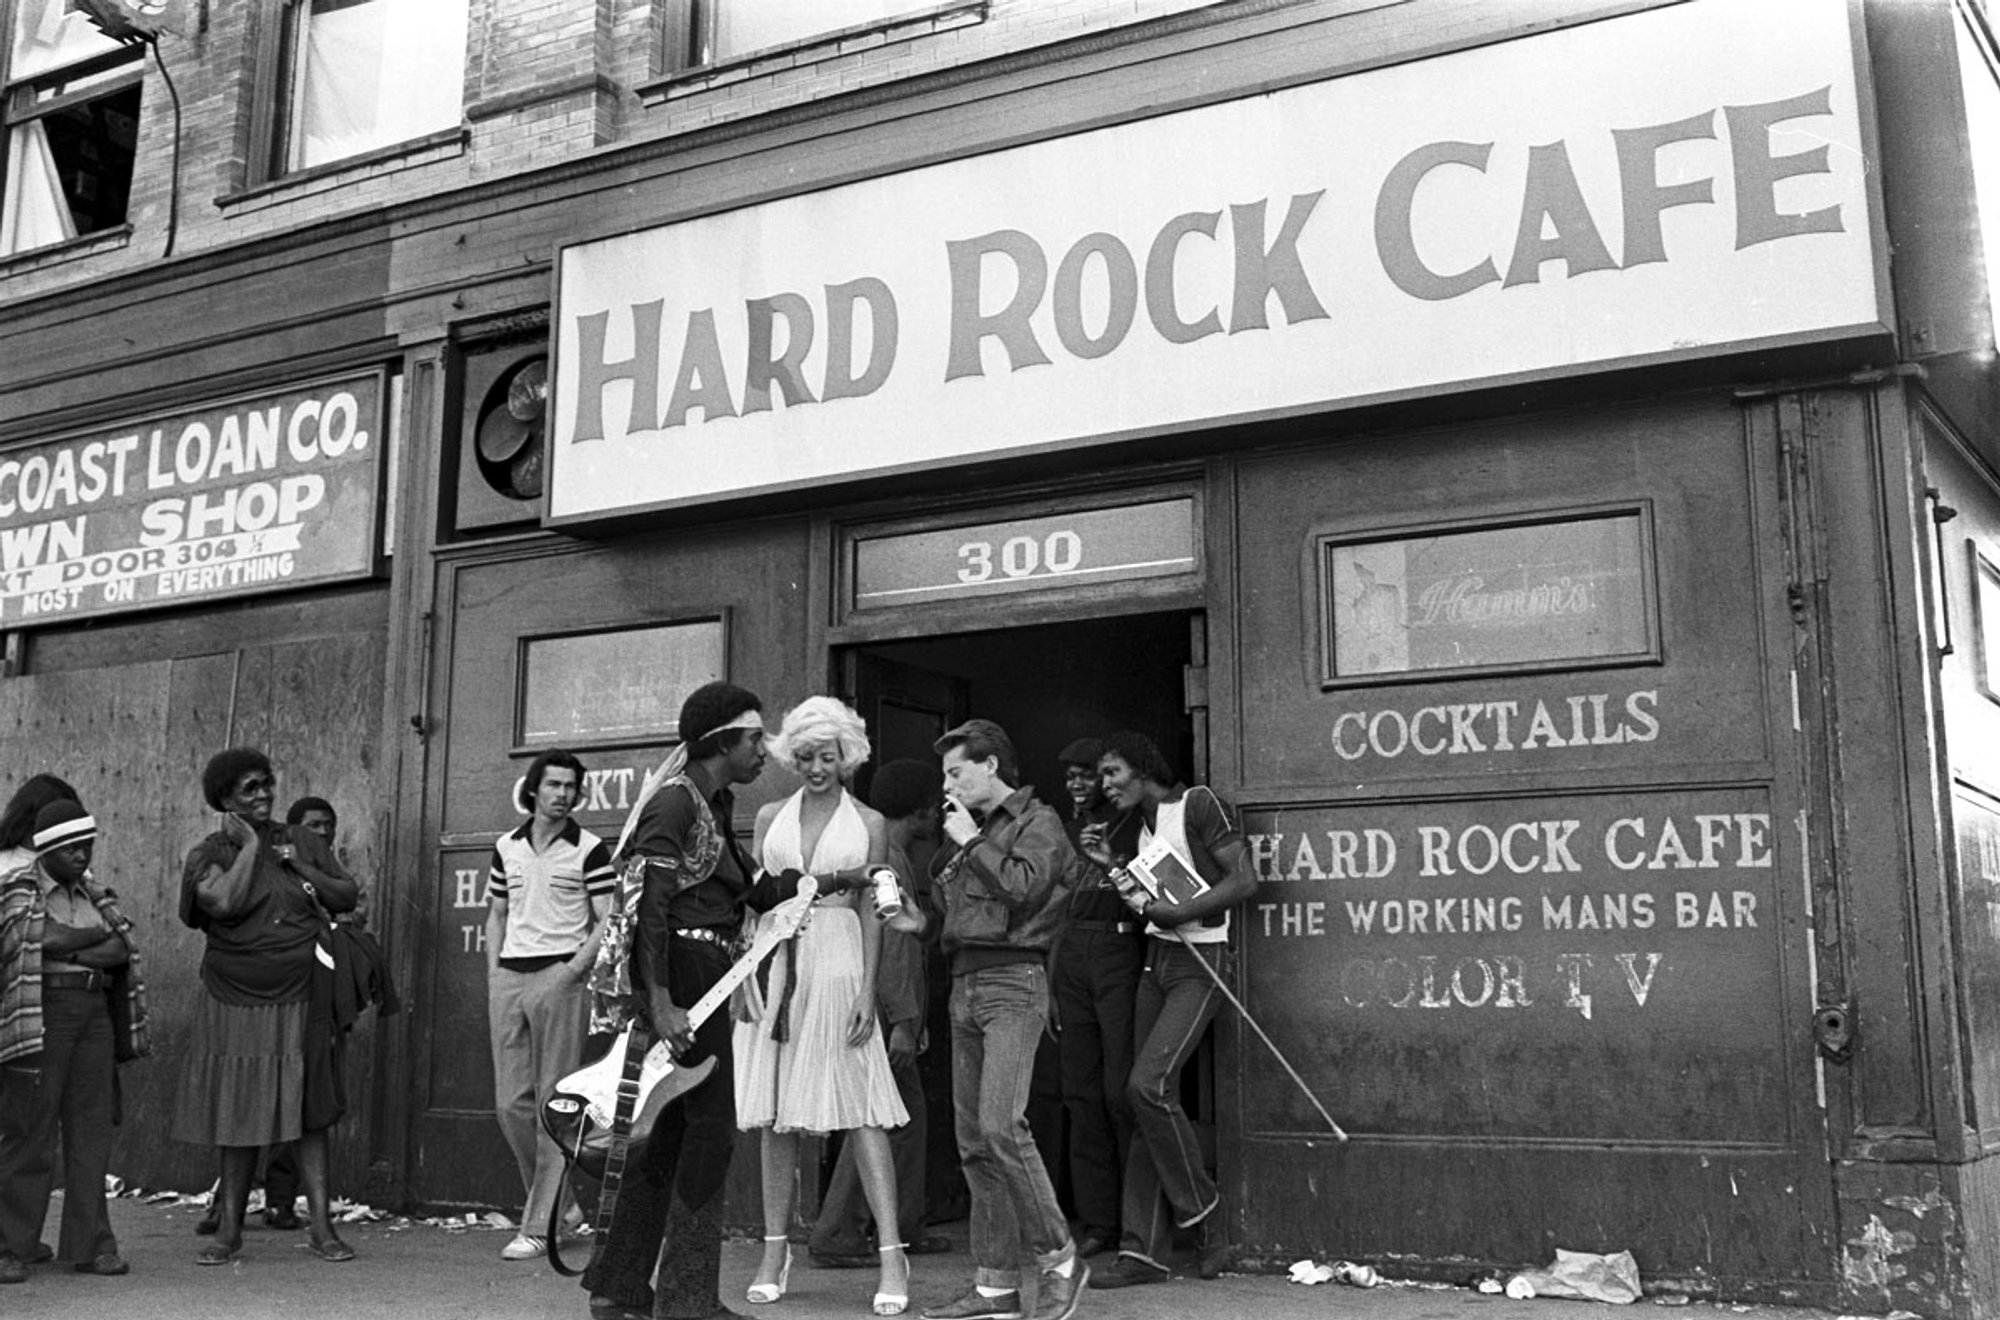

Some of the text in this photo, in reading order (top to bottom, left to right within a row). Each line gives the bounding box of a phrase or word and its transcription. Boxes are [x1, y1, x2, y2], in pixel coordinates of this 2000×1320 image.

[571, 84, 1847, 444] HARD ROCK CAFE
[0, 391, 369, 519] COAST LOAN CO.
[139, 474, 326, 548] SHOP
[22, 587, 83, 616] MOST
[104, 580, 135, 602] ON
[157, 552, 295, 596] EVERYTHING
[61, 548, 165, 582] DOOR
[177, 538, 237, 565] 304
[957, 530, 1082, 583] 300
[1332, 690, 1660, 760] COCKTAILS
[1247, 813, 1773, 882] HARD ROCK CAFE
[1258, 891, 1758, 937] THE WORKING MANS BAR
[1614, 952, 1664, 1007] V
